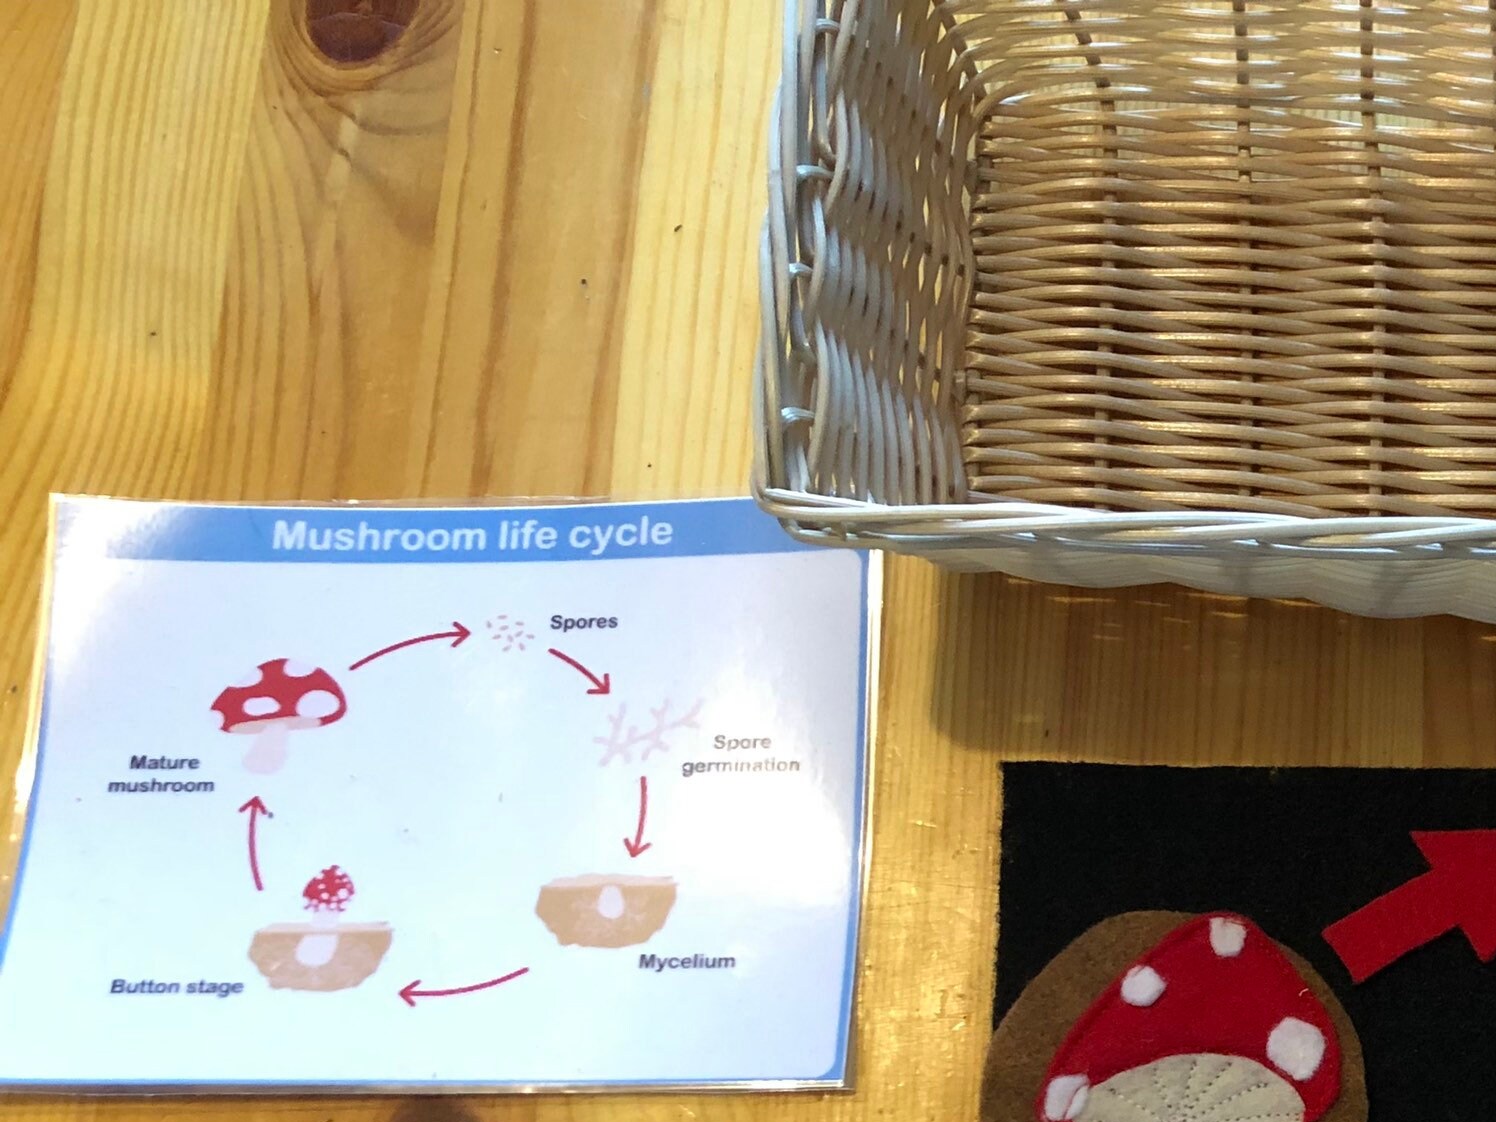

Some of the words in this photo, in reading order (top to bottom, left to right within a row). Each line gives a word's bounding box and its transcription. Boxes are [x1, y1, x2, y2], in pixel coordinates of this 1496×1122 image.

[272, 520, 486, 551] Mushroom
[499, 519, 558, 549] life
[569, 515, 674, 555] cycle
[550, 615, 619, 630] Spores
[713, 735, 771, 751] Spore
[129, 755, 201, 769] Mature
[682, 758, 801, 777] germination
[107, 778, 215, 792] mushroom
[638, 954, 736, 972] Mycelium
[110, 979, 180, 994] Button
[186, 980, 244, 998] stage
